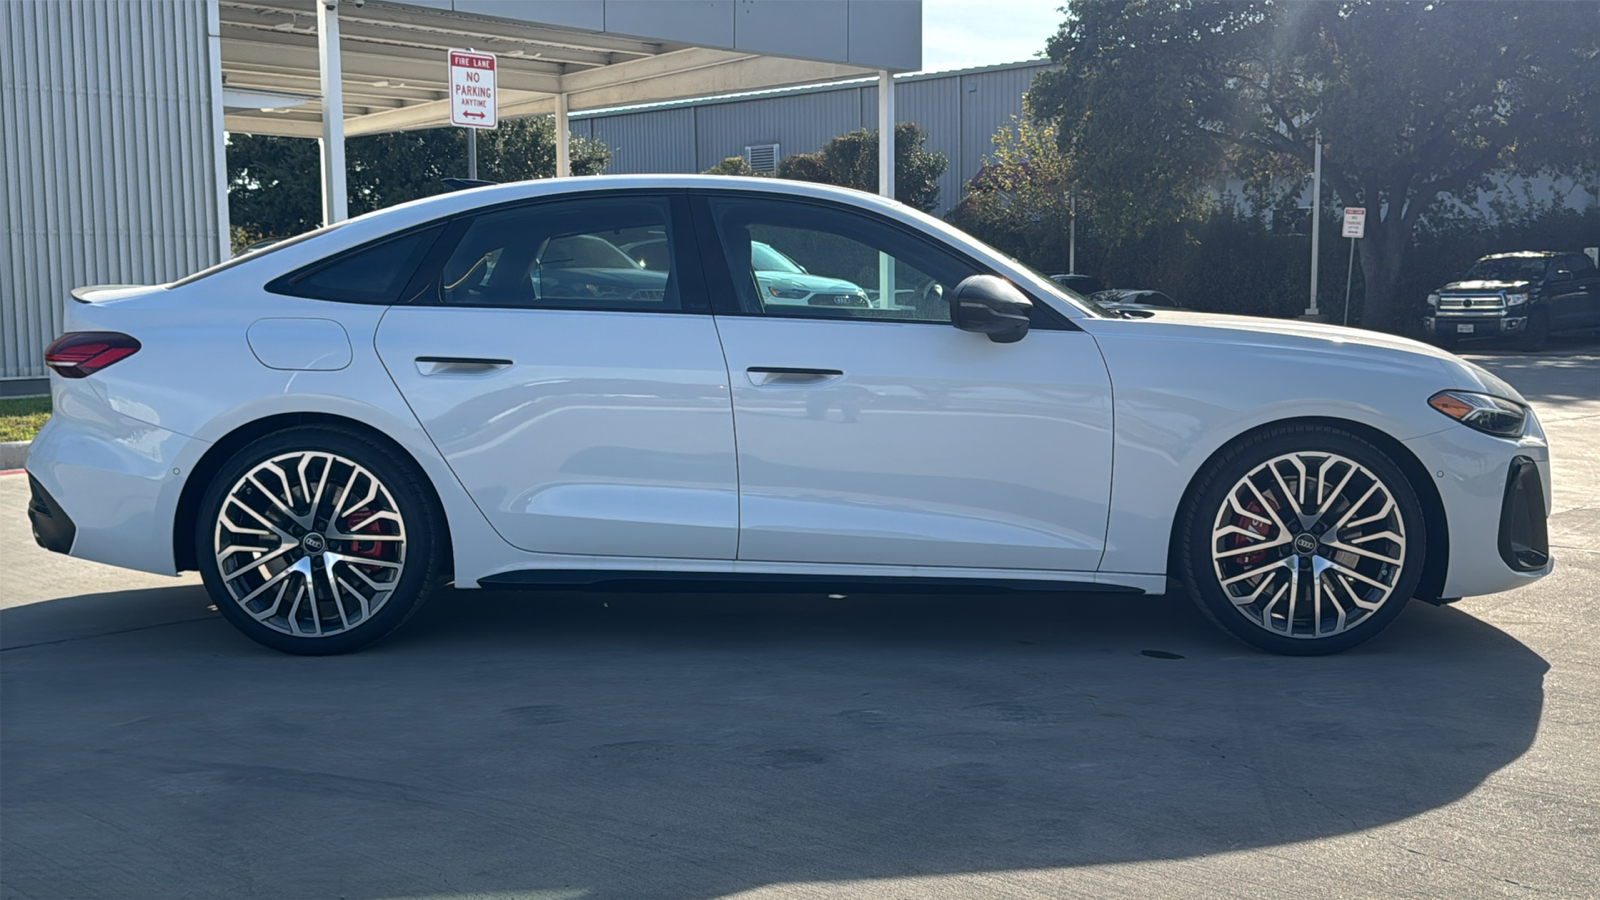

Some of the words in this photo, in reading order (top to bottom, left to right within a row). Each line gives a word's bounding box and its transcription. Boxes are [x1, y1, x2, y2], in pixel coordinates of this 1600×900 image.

[454, 56, 470, 66] FIRE
[472, 59, 490, 68] LANE
[466, 71, 480, 83] NO
[455, 84, 491, 98] PARKING
[461, 98, 486, 108] ANYTIME
